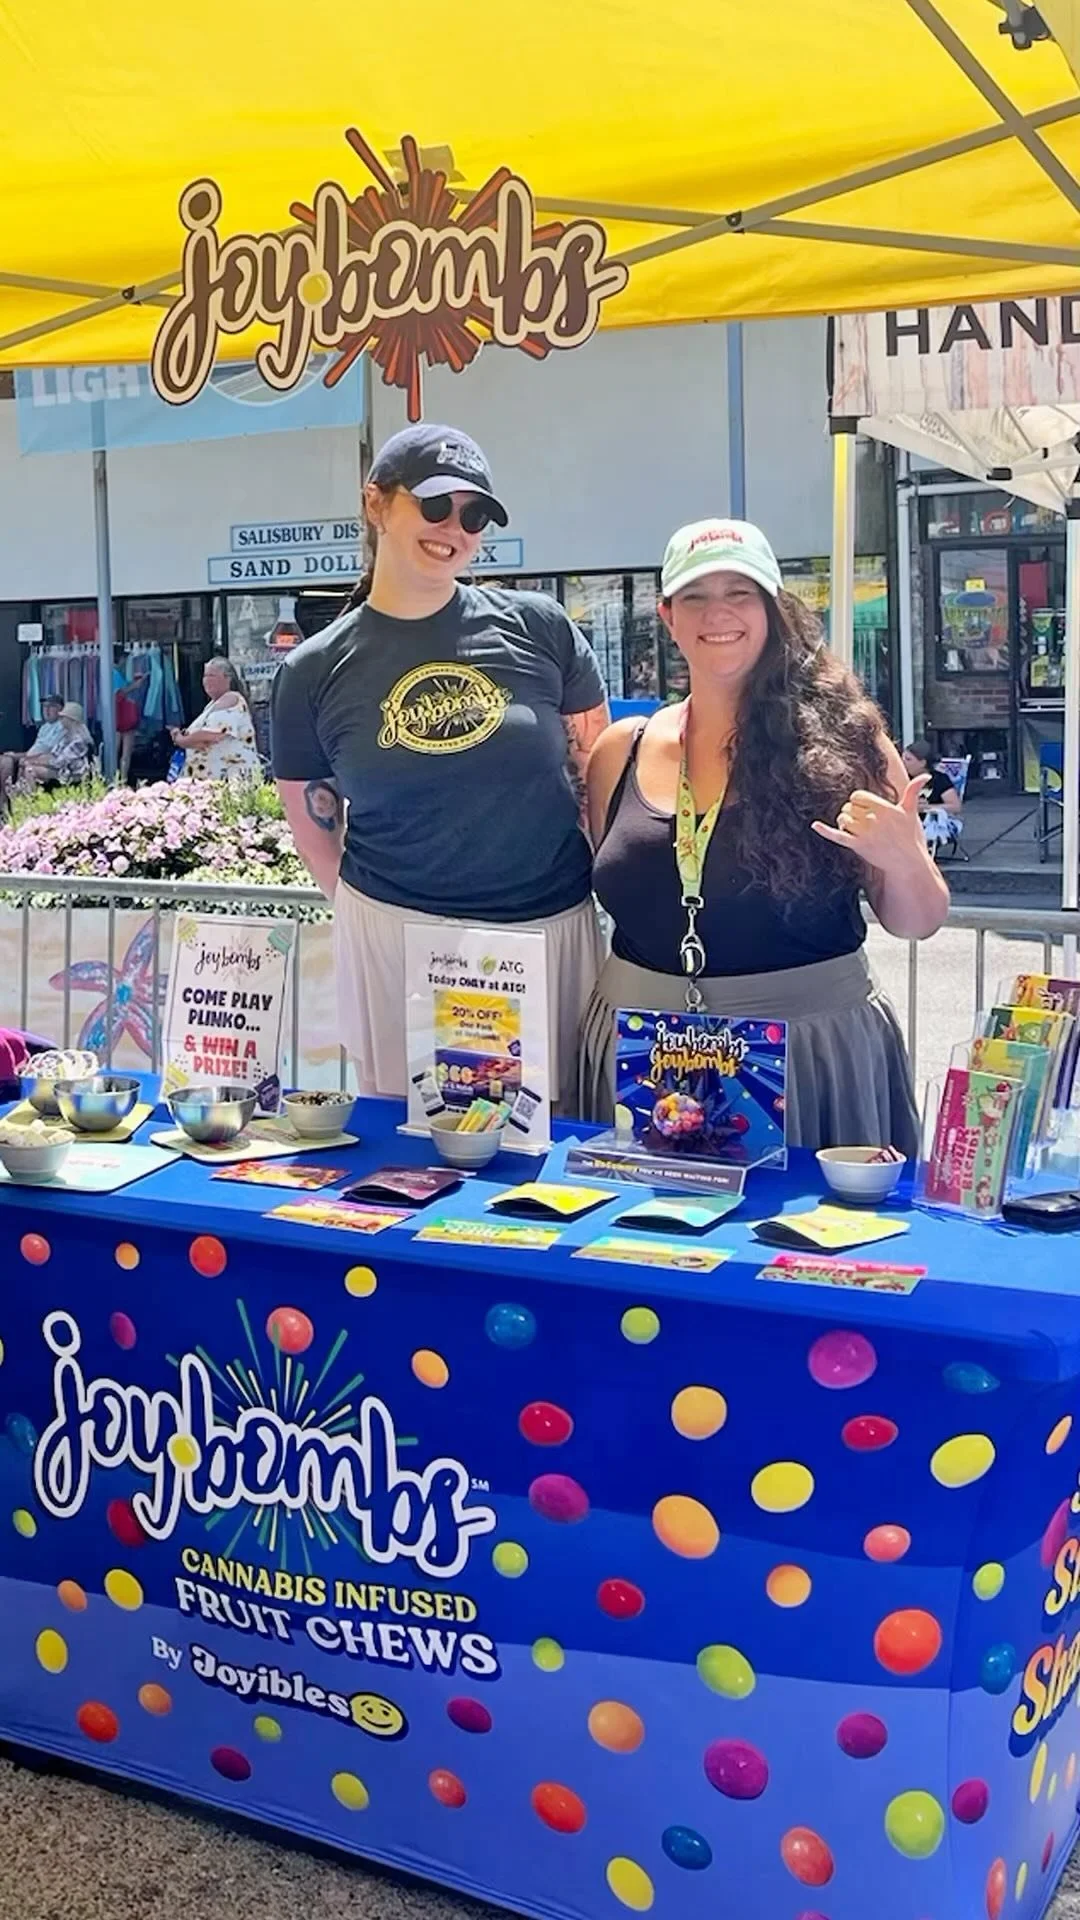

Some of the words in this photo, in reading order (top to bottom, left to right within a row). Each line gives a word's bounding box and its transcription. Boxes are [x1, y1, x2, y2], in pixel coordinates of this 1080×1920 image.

[152, 178, 628, 404] joybombs
[32, 365, 140, 407] LIGH
[238, 525, 324, 546] SALISBURY
[333, 522, 363, 539] DIS
[230, 558, 291, 578] SAND
[304, 554, 364, 574] DOLL
[428, 973, 456, 987] Today
[182, 987, 227, 1007] COME
[231, 991, 273, 1011] PLAY
[188, 1009, 260, 1032] PLINKO...
[184, 1034, 197, 1053] &
[203, 1035, 239, 1058] WIN
[245, 1039, 257, 1059] A
[193, 1056, 248, 1080] PRIZE!
[34, 1310, 497, 1579] joybombs
[181, 1547, 327, 1608] CANNABIS
[335, 1581, 478, 1623] INFUSED
[174, 1577, 291, 1640] FRUIT
[305, 1616, 499, 1676] CHEWS
[151, 1636, 182, 1670] By
[191, 1645, 352, 1719] Joyibles
